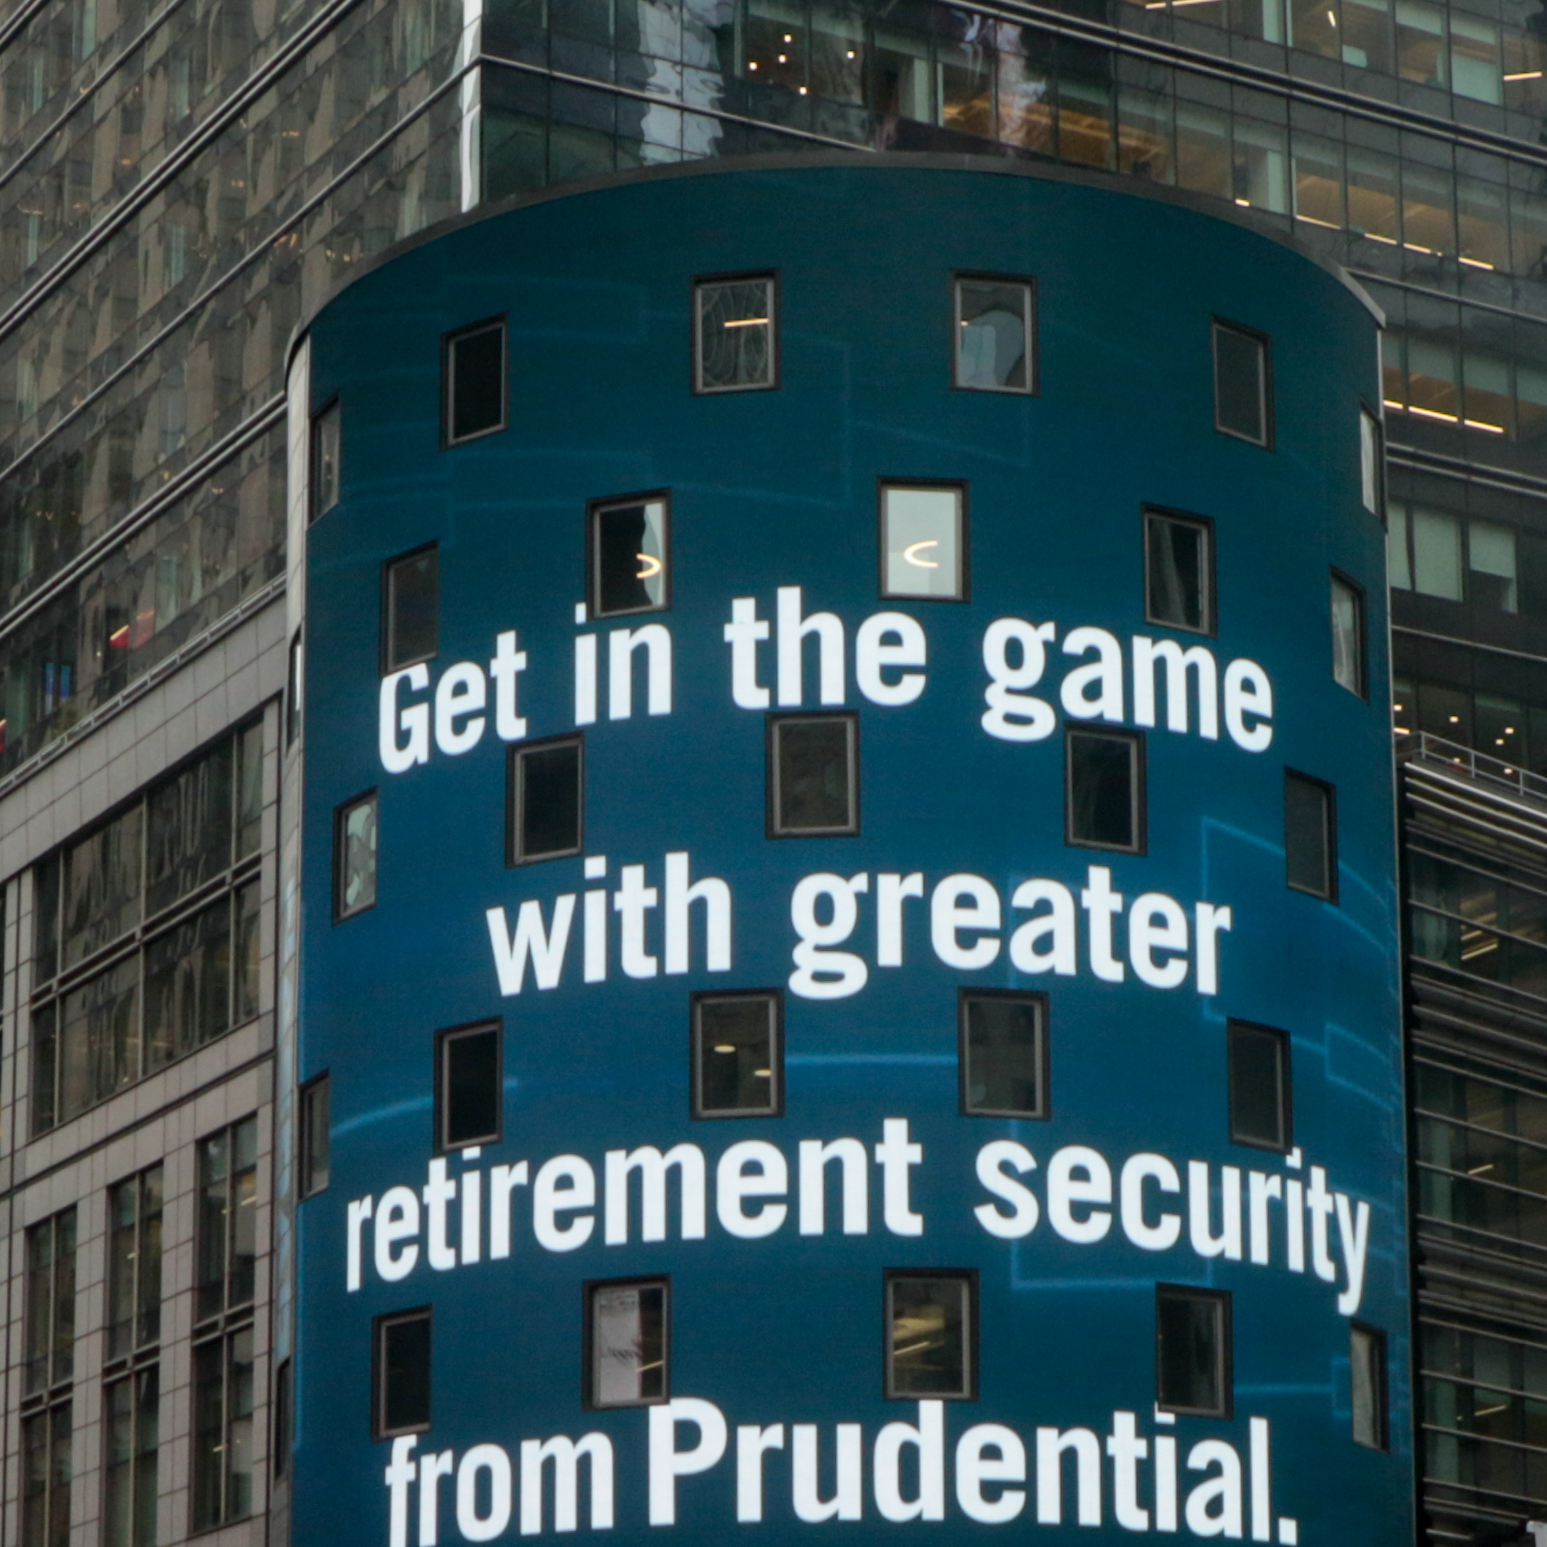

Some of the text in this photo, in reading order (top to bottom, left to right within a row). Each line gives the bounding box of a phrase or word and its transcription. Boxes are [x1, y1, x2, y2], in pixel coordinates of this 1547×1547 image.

[378, 586, 1274, 775] Get in the game
[485, 852, 1232, 999] with greater
[346, 1118, 1370, 1315] retirement security
[649, 1397, 1298, 1546] Prudential.
